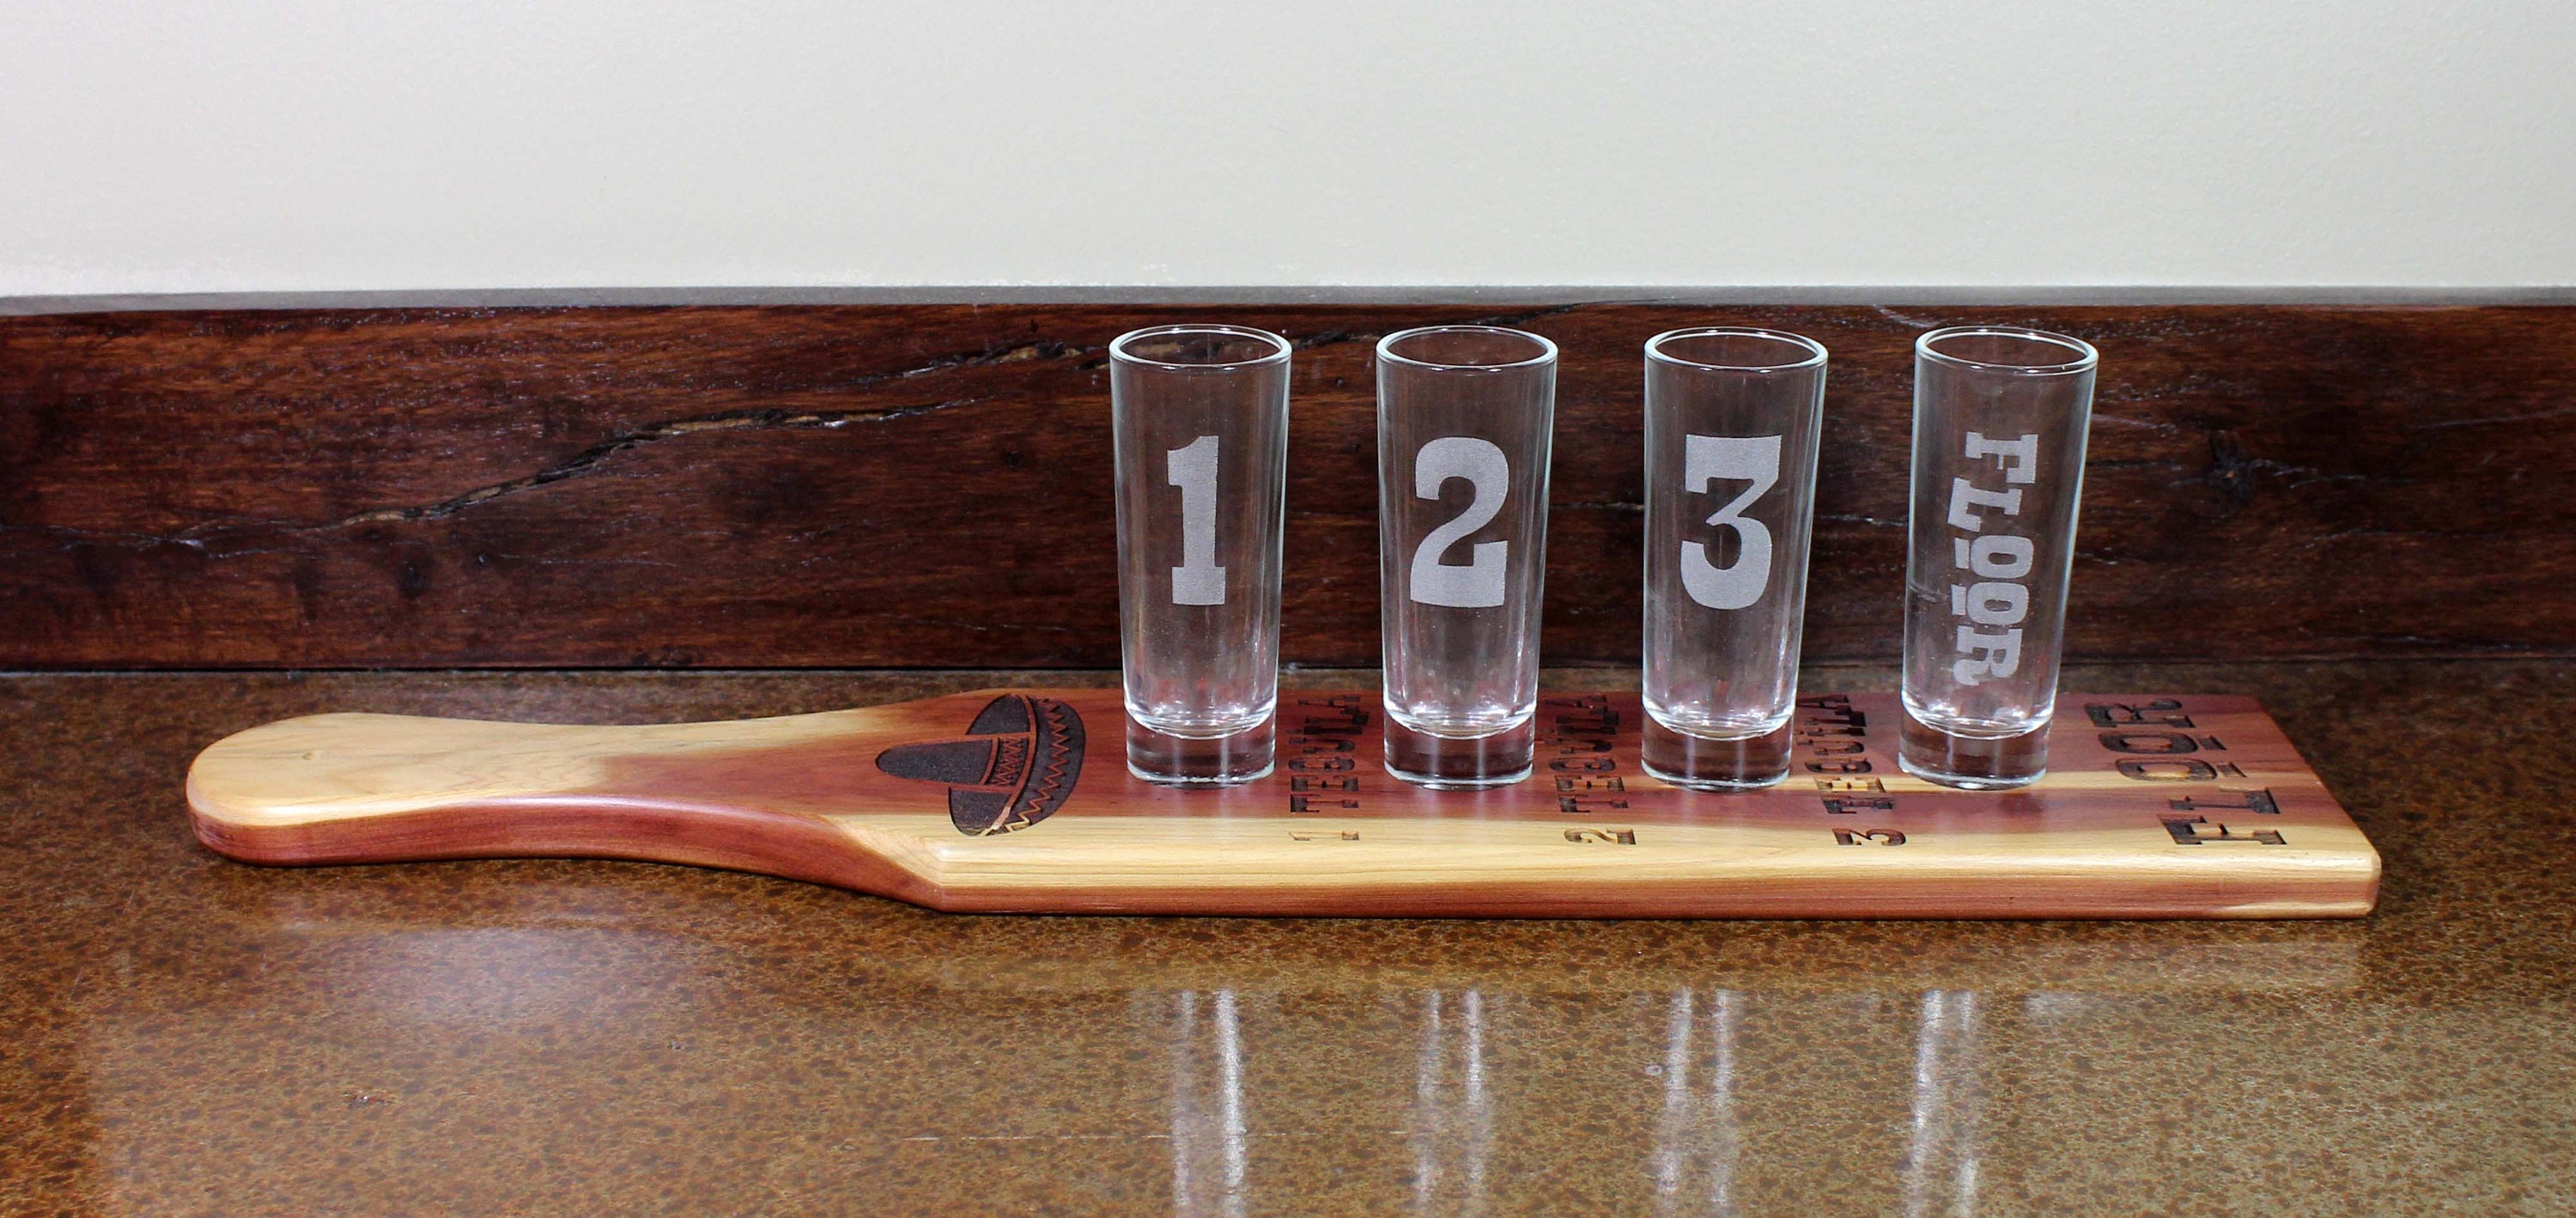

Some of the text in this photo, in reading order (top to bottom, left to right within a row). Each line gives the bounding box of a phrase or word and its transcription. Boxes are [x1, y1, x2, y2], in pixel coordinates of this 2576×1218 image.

[1166, 435, 1226, 606] 1
[1409, 436, 1510, 608] 2
[1680, 433, 1783, 611] 3
[1947, 430, 2038, 686] FLOOR
[1286, 694, 1370, 841] 1 TEQUILA
[1543, 694, 1637, 845] 2 TEQUILA
[1794, 692, 1907, 846] 3 TEQUILA
[2083, 697, 2287, 845] FLOOR
